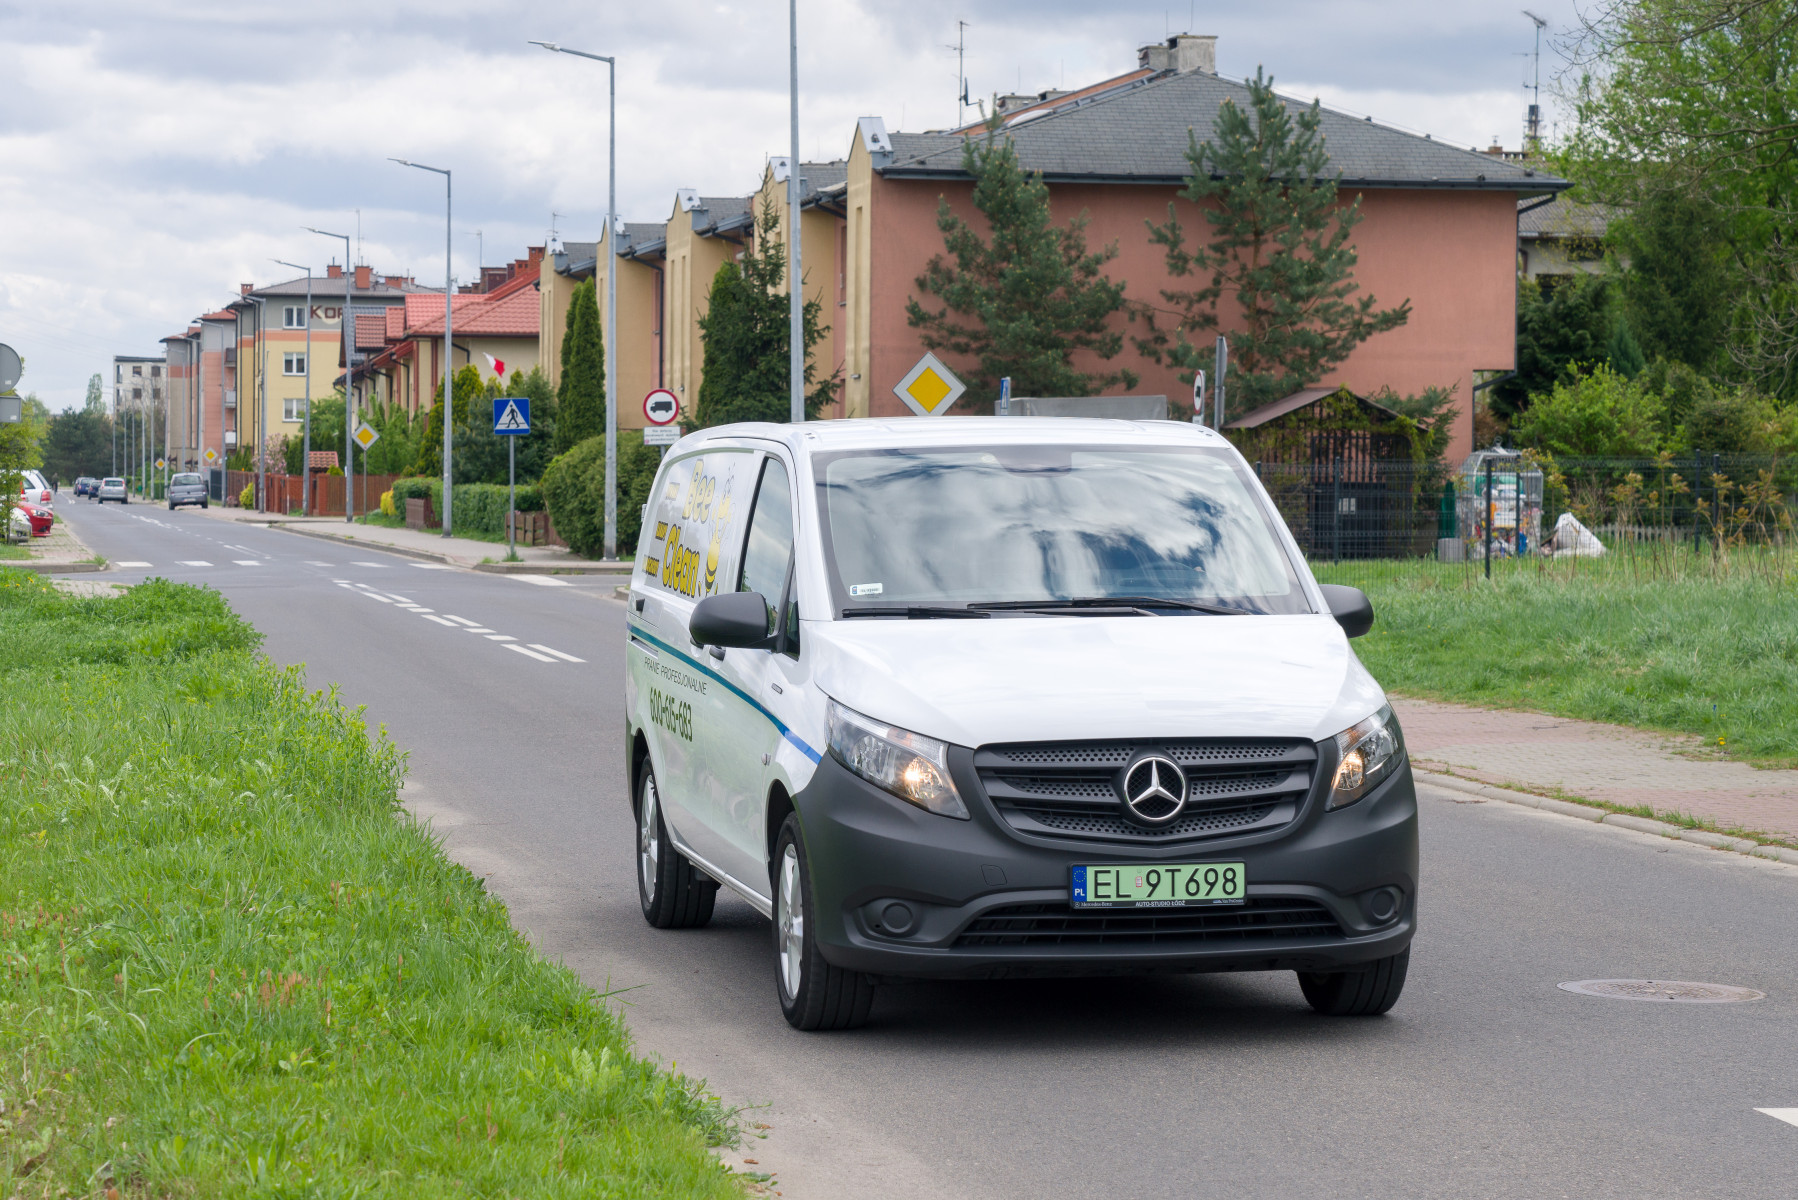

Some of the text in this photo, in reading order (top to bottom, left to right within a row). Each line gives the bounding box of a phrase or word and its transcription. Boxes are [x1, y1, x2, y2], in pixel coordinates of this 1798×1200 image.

[682, 458, 716, 525] Bee
[662, 523, 700, 599] Clean
[644, 656, 708, 696] PRANIE PROFESJONALNE
[650, 686, 693, 743] 600-615-683
[1074, 888, 1086, 897] PL
[1094, 869, 1132, 899] EL
[1146, 867, 1237, 898] 9T698
